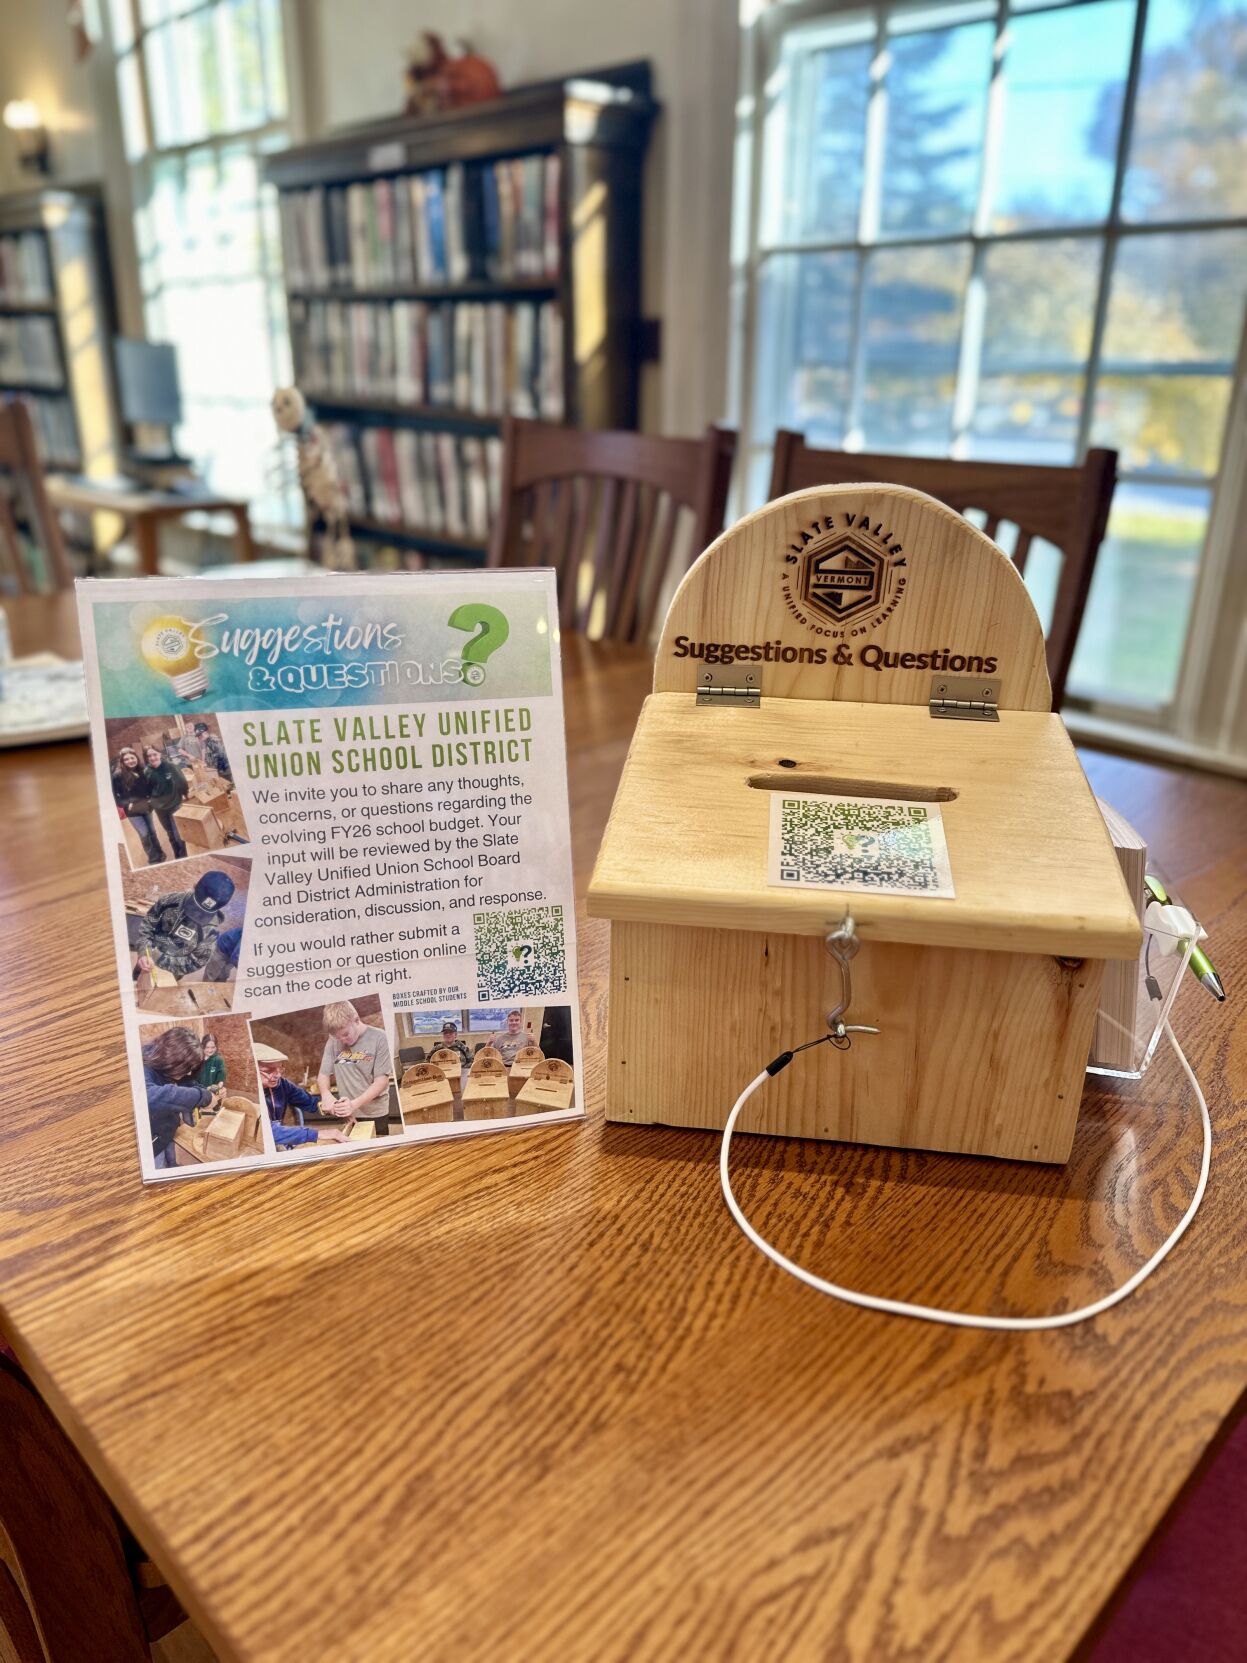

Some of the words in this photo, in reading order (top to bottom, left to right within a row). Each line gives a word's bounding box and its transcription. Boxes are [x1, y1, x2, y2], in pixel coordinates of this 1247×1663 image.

[786, 516, 834, 564] SLATE
[845, 513, 907, 567] VALLEY
[816, 575, 868, 584] VERMONT
[782, 586, 807, 625] UNIFIED
[810, 624, 845, 638] FOCUS
[851, 627, 867, 637] ON
[871, 577, 906, 628] LEARNING
[186, 613, 405, 665] Suggestions
[673, 635, 827, 665] Suggestions
[833, 643, 853, 666] &
[860, 645, 998, 674] Questions
[248, 664, 274, 692] &
[278, 659, 464, 693] QUESTIONS
[242, 718, 323, 747] SLATE
[334, 713, 426, 742] VALLEY
[438, 707, 532, 736] UNIFIED
[246, 750, 322, 779] UNION
[332, 746, 422, 774] SCHOOL
[432, 738, 533, 768] DISTRICT
[252, 790, 279, 804] We
[285, 787, 325, 802] invite
[330, 787, 357, 802] you
[362, 785, 376, 796] to
[382, 782, 422, 794] share
[428, 780, 453, 793] any
[458, 774, 524, 790] thoughts,
[259, 809, 336, 824] concerns,
[342, 808, 356, 818] or
[361, 802, 433, 819] questions
[438, 795, 506, 813] regarding
[510, 793, 532, 806] the
[262, 829, 326, 844] evolving
[331, 824, 371, 839] FY26
[376, 820, 424, 836] school
[430, 816, 484, 832] budget.
[488, 814, 522, 827] Your
[267, 852, 306, 867] input
[310, 847, 334, 861] will
[340, 846, 358, 859] be
[363, 839, 429, 857] reviewed
[434, 838, 451, 853] by
[456, 837, 478, 849] the
[483, 834, 519, 847] Slate
[265, 871, 312, 886] Valley
[317, 864, 370, 881] Unified
[376, 862, 419, 876] Union
[424, 856, 473, 872] School
[478, 852, 520, 866] Board
[263, 892, 291, 906] and
[297, 886, 350, 903] District
[355, 878, 459, 898] Administration
[464, 875, 483, 887] for
[255, 908, 361, 928] consideration,
[365, 900, 445, 916] discussion,
[450, 894, 475, 908] and
[480, 890, 546, 906] response.
[254, 943, 263, 956] If
[268, 942, 295, 958] you
[300, 934, 345, 951] would
[351, 932, 394, 946] rather
[399, 924, 447, 941] submit
[452, 925, 460, 935] a
[247, 958, 331, 978] suggestion
[337, 956, 351, 967] or
[356, 948, 418, 967] question
[424, 943, 466, 957] online
[244, 985, 281, 998] scan
[286, 980, 310, 992] the
[315, 975, 352, 990] code
[358, 972, 371, 984] at
[376, 968, 411, 984] right.
[393, 992, 410, 1000] BOXES
[413, 989, 437, 997] CRAFTED
[416, 996, 437, 1005] SCHOOL
[439, 993, 467, 1002] STUDENTS
